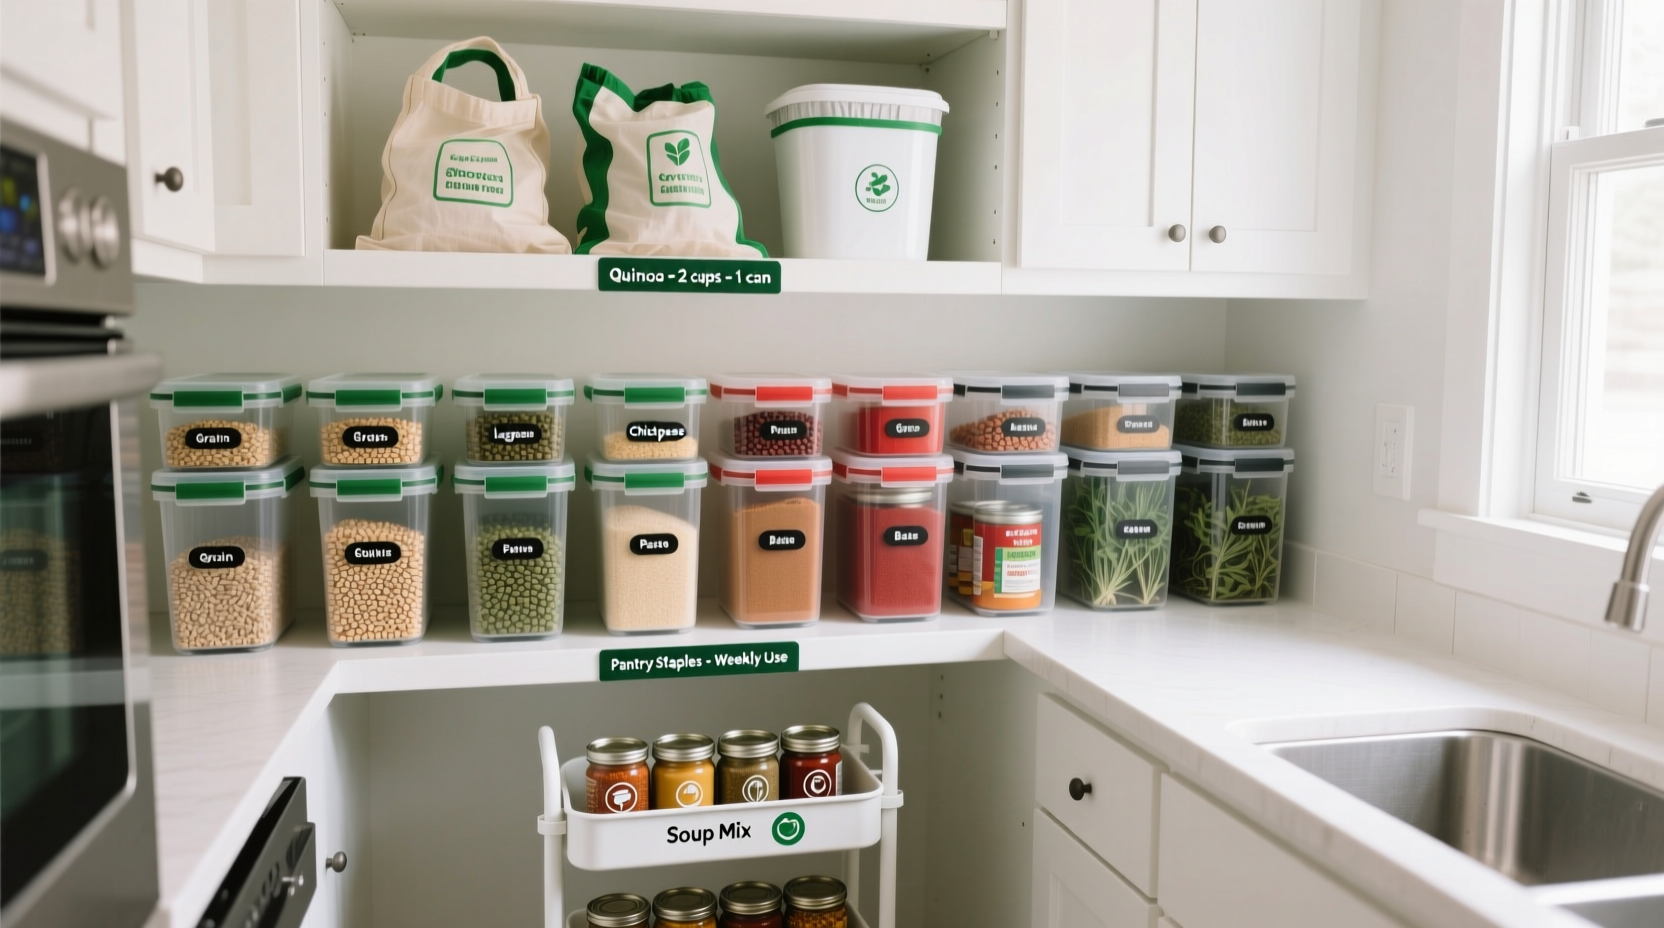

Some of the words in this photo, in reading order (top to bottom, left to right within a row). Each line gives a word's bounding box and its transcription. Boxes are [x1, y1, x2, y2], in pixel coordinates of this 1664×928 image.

[609, 267, 664, 283] Quinoa
[677, 268, 687, 283] 2
[690, 271, 722, 287] cups
[735, 269, 742, 283] 1
[745, 273, 772, 284] can
[611, 658, 653, 673] Pantry
[655, 654, 702, 672] Staples
[714, 651, 761, 667] Weekly
[764, 651, 789, 664] Use
[667, 826, 714, 846] Soup
[719, 821, 751, 840] Mix
